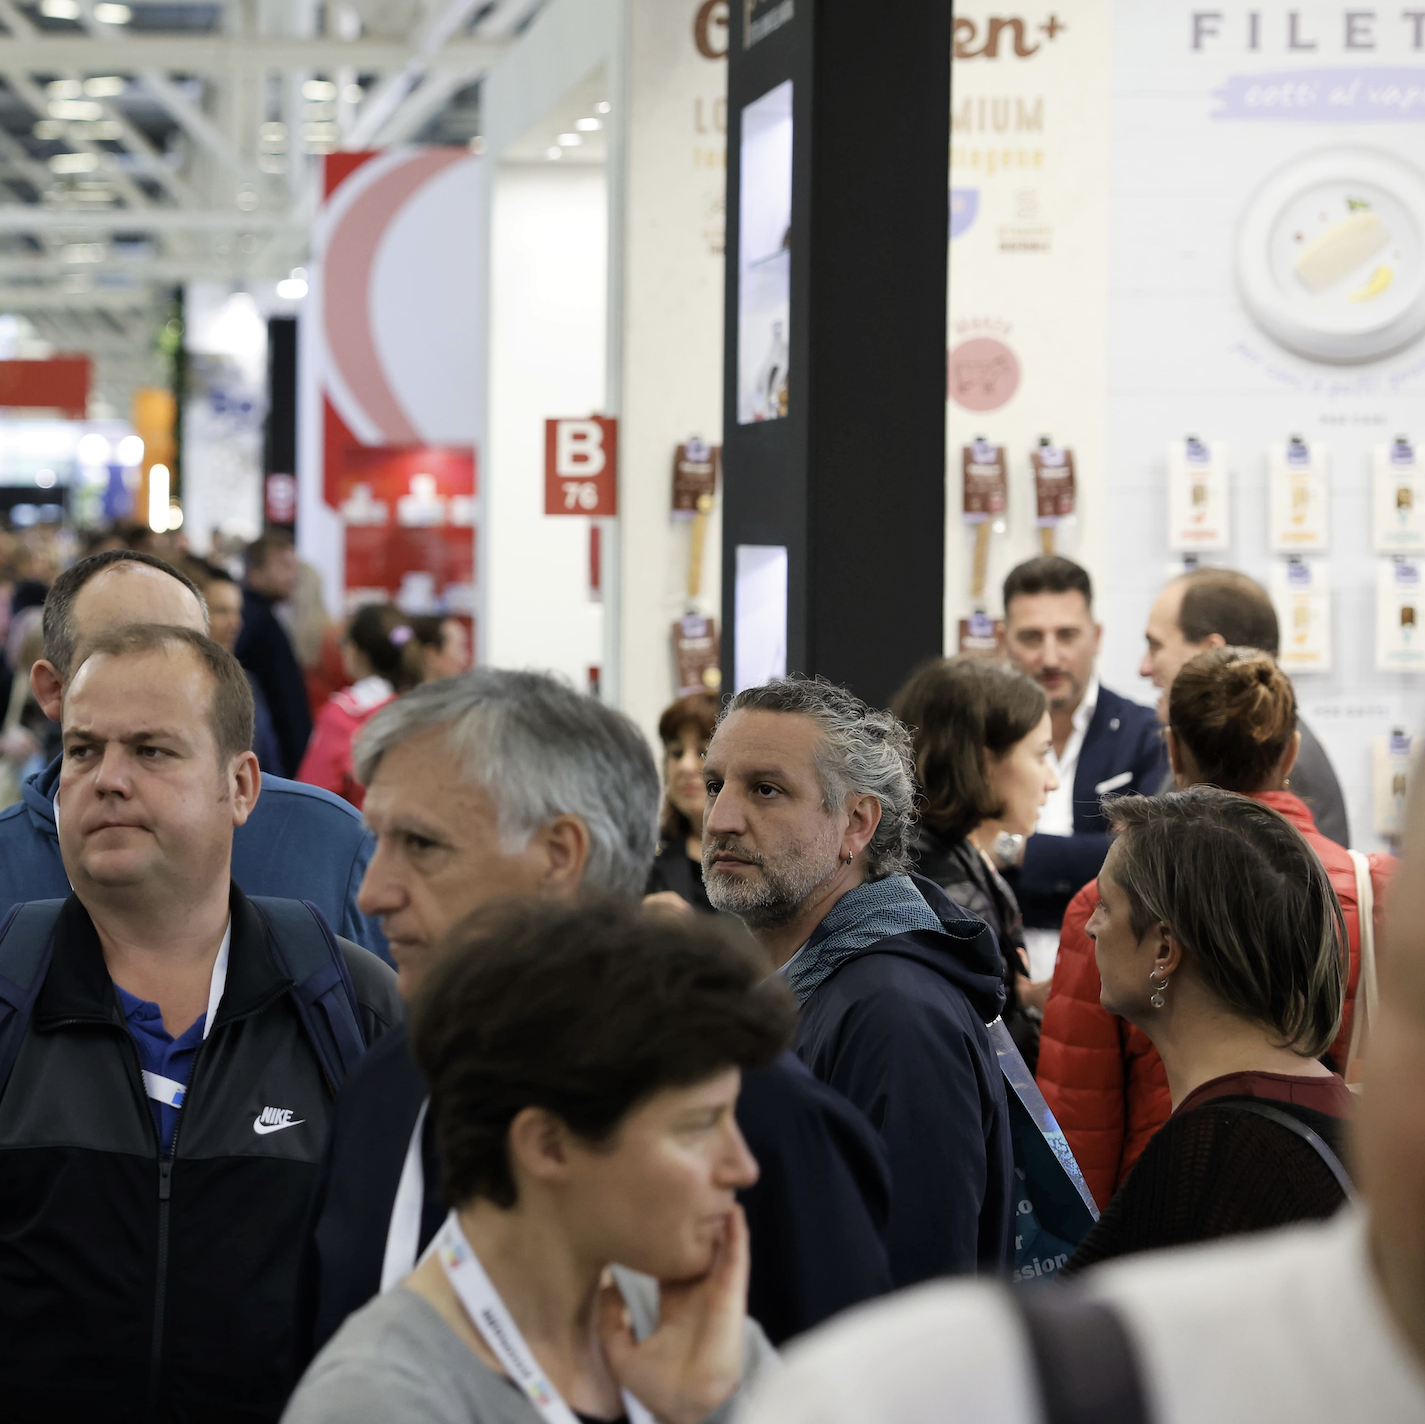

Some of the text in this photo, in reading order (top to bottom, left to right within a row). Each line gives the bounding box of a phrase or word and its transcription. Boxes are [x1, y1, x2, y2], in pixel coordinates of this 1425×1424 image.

[556, 420, 606, 478] B
[560, 481, 599, 510] 76
[260, 1106, 294, 1124] NIKE
